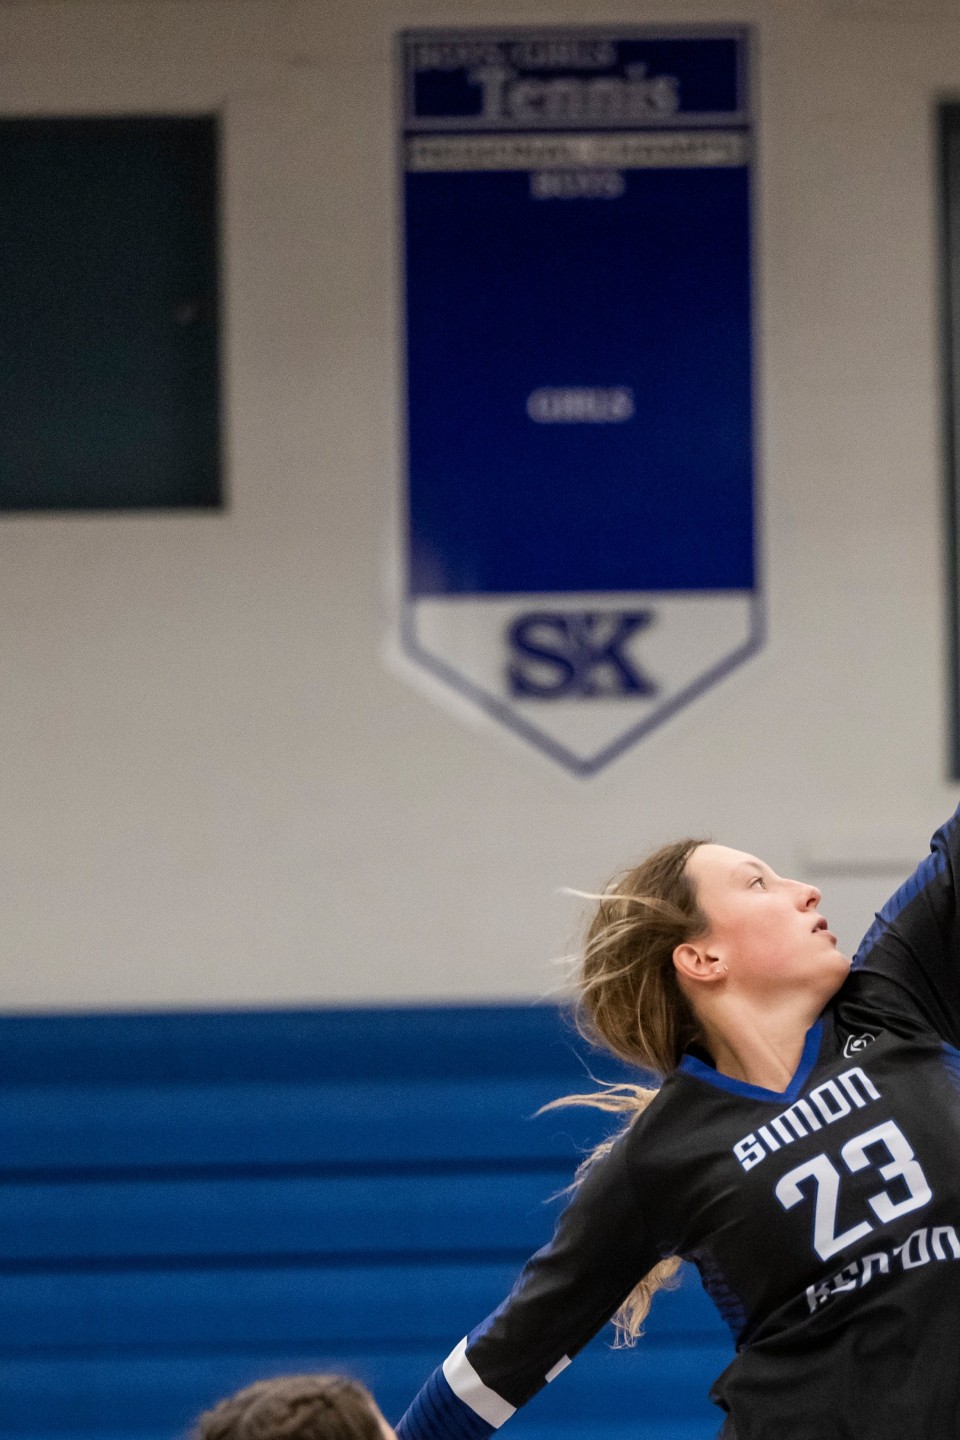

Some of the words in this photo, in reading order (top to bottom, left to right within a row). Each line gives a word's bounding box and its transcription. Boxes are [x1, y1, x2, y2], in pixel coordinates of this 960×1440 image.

[465, 62, 680, 120] Tennis
[505, 608, 658, 701] SK
[732, 1065, 882, 1173] SIMON
[773, 1119, 933, 1263] 23
